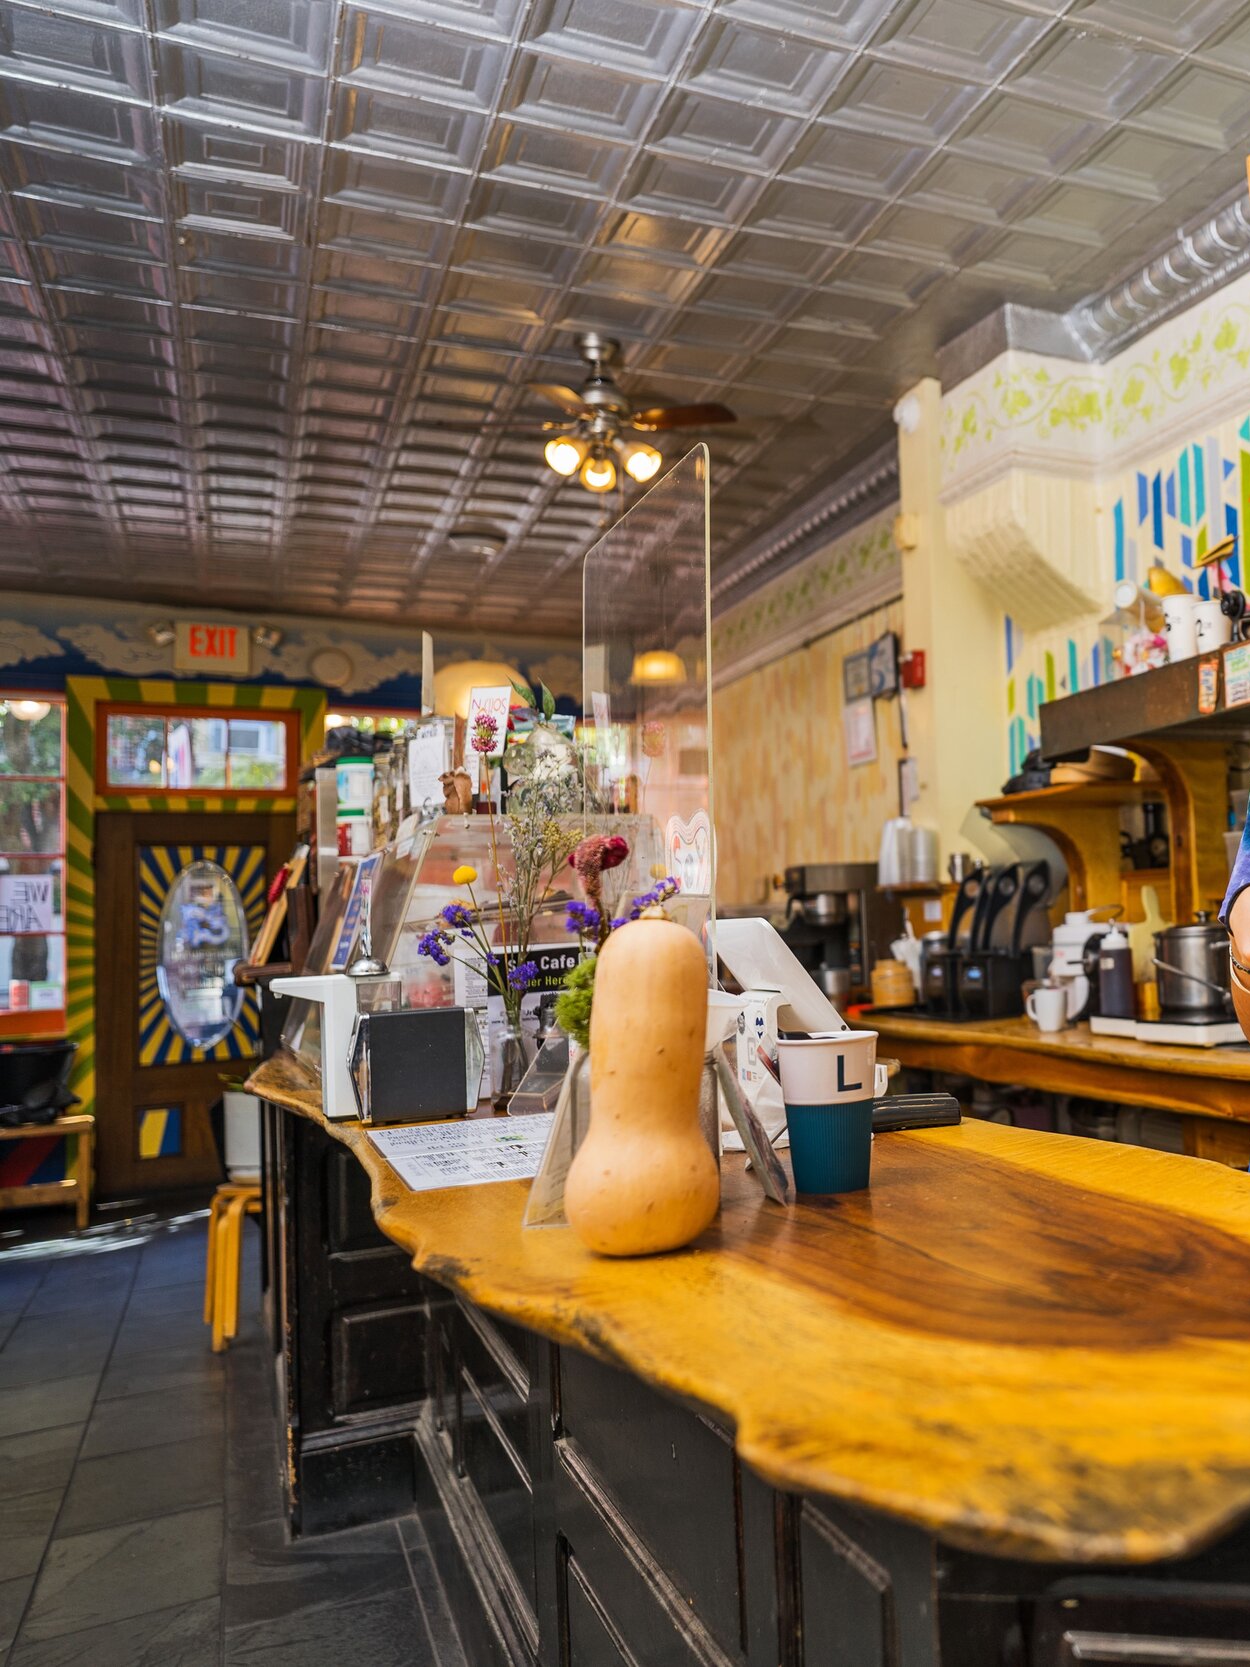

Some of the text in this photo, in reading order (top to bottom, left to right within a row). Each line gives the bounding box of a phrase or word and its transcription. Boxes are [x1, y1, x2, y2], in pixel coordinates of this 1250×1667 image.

[189, 624, 238, 659] EXIT
[540, 954, 576, 970] Cafe
[837, 1055, 862, 1092] L
